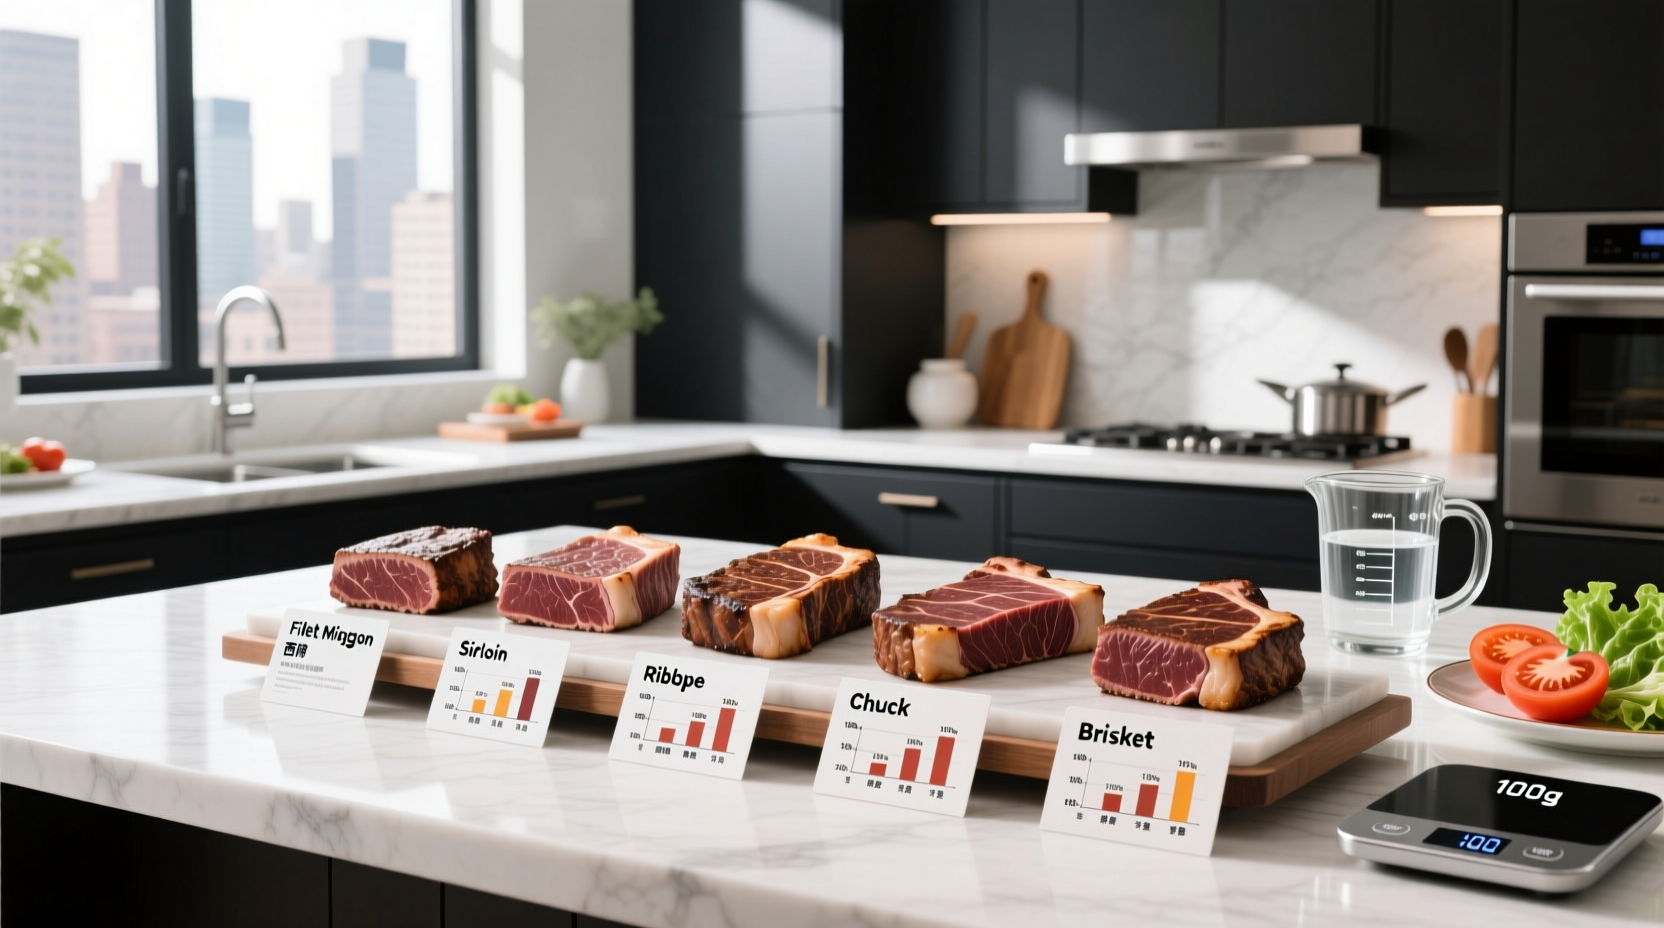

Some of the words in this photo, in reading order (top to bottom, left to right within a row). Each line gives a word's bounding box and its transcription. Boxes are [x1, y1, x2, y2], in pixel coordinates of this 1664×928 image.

[289, 620, 320, 640] Filet
[458, 640, 508, 662] Sirloin
[643, 665, 706, 693] Ribbpe
[849, 692, 912, 717] Chuck
[1077, 722, 1155, 750] Brisket
[1496, 779, 1564, 807] 100g
[1459, 834, 1502, 854] 100
